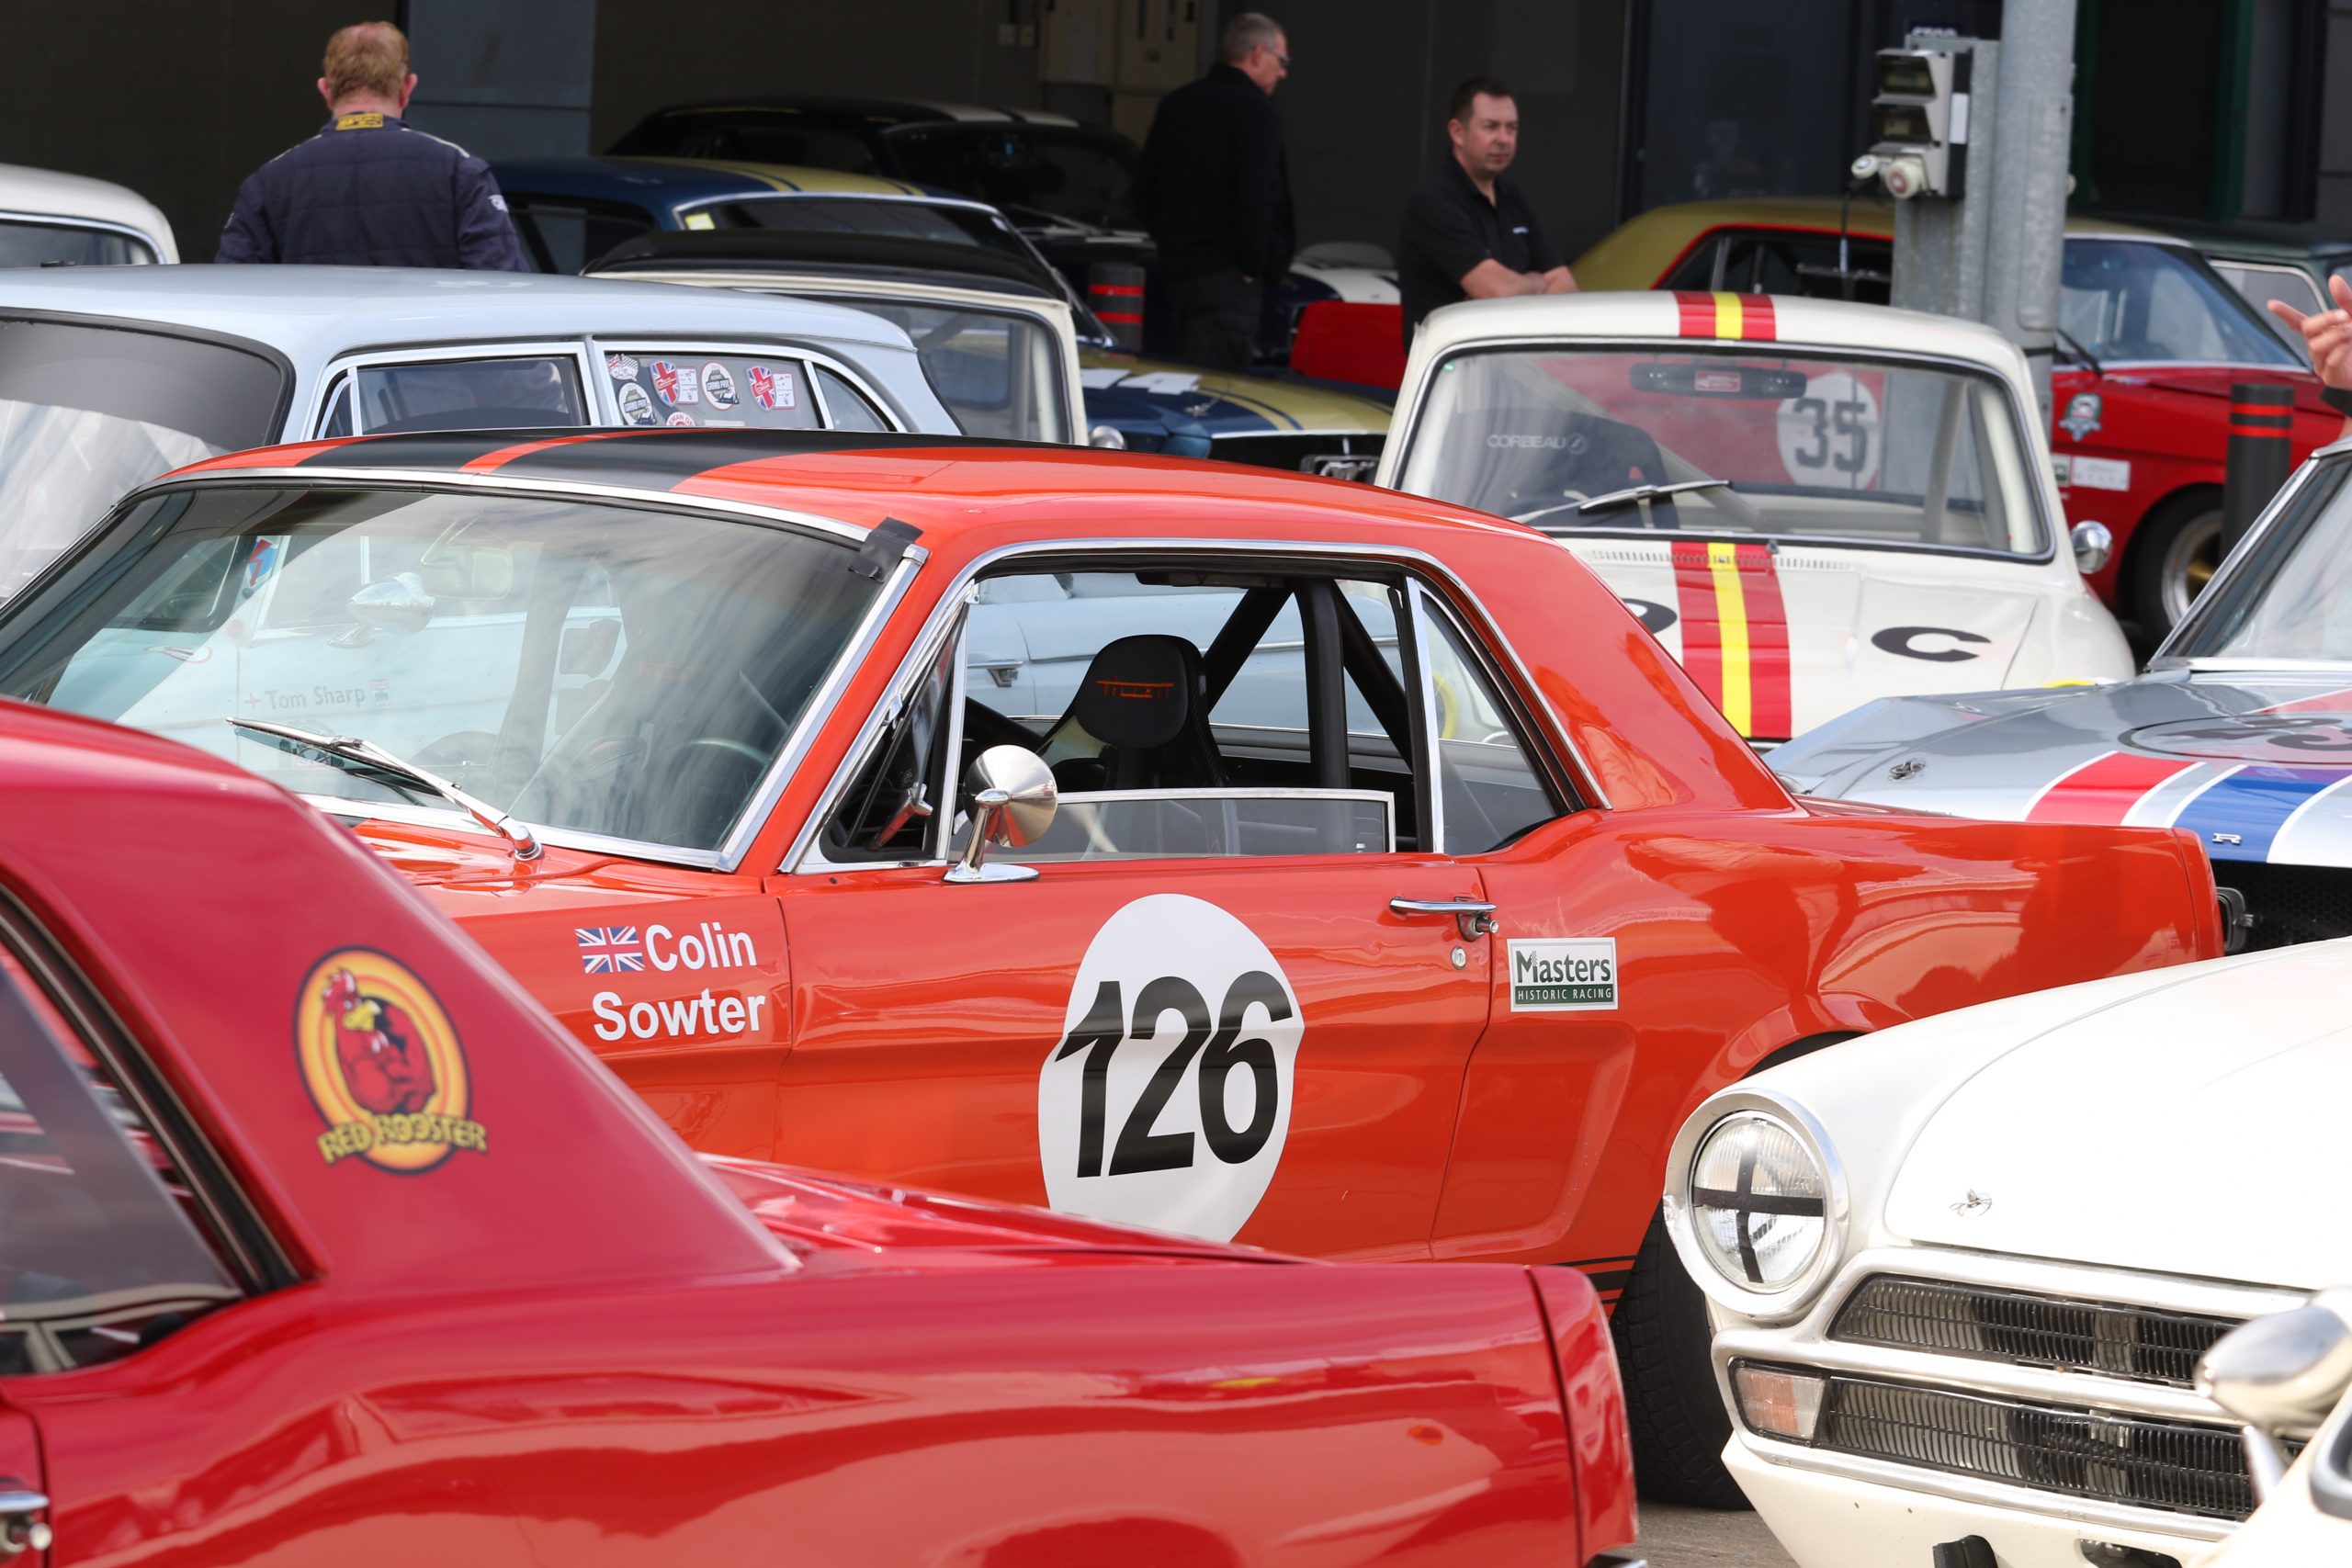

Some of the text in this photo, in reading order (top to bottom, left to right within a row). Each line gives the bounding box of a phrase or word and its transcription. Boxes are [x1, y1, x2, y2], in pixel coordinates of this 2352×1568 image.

[1487, 434, 1566, 449] CORBEAU
[1792, 398, 1868, 473] 35
[265, 685, 366, 710] Tom Sharp
[645, 922, 757, 971] Colin
[1516, 950, 1611, 983] Masters
[593, 987, 765, 1041] Sowter
[1518, 987, 1611, 1000] HISTORIC RACING
[1054, 970, 1293, 1178] 126
[317, 1112, 487, 1165] RED ROOSTER
